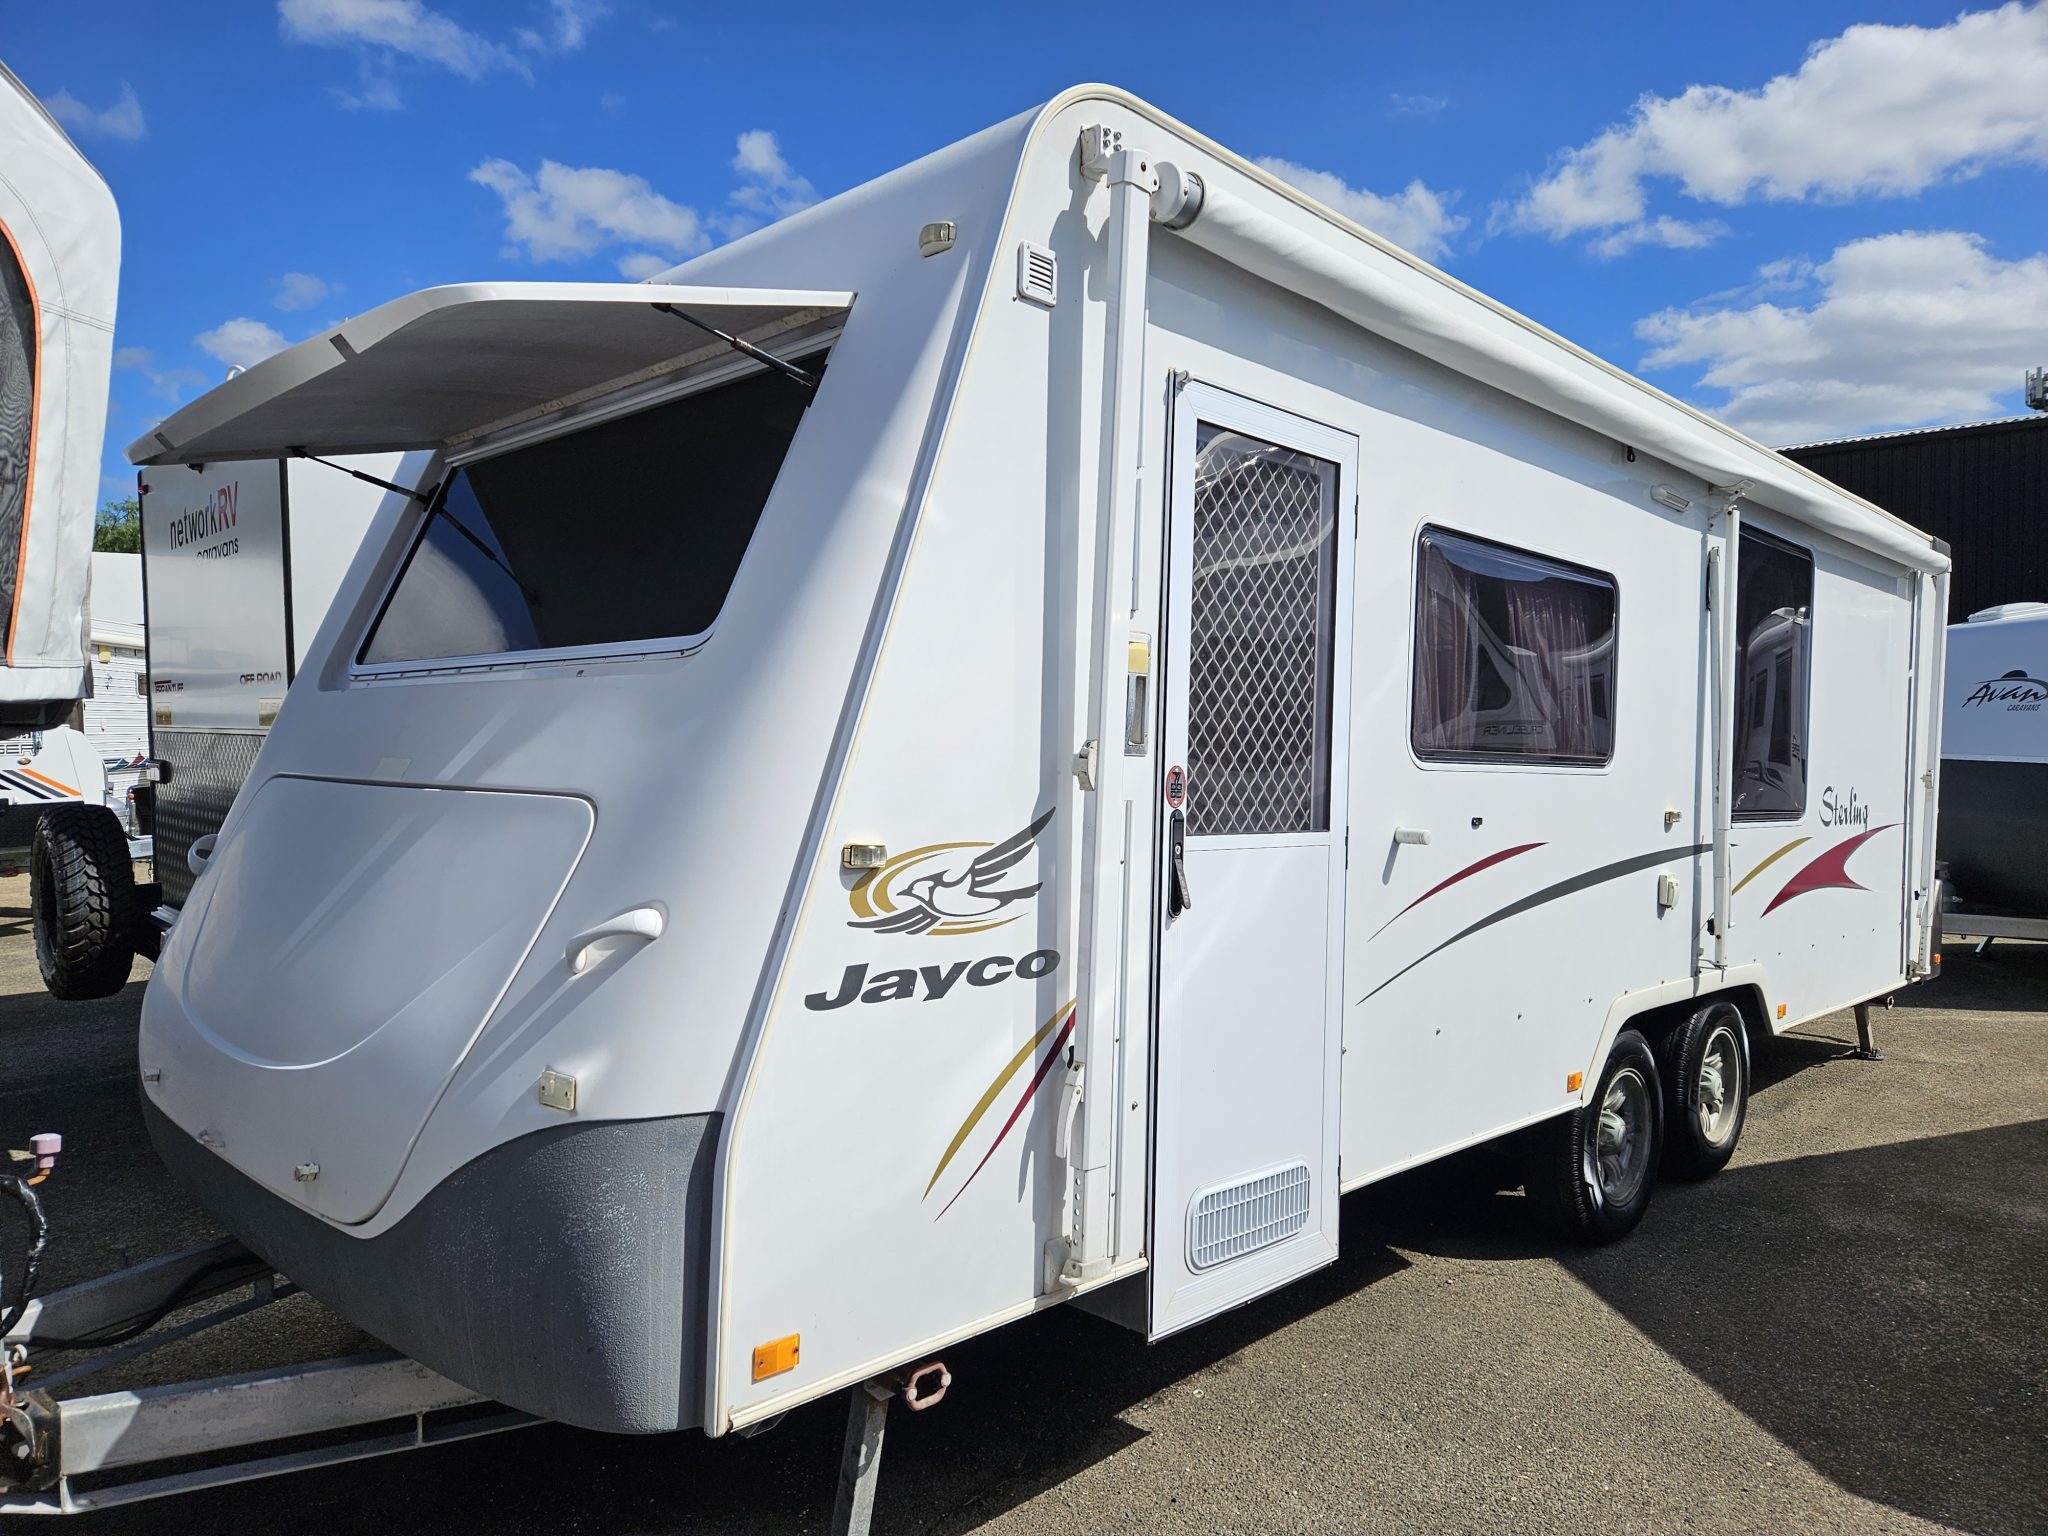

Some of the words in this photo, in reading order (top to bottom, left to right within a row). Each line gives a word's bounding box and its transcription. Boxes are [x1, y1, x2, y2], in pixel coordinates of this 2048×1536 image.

[1961, 682, 2046, 708] Avan
[2006, 704, 2042, 712] CARAVANS
[1818, 785, 1870, 832] Sterling
[804, 949, 1061, 1012] Jayco
